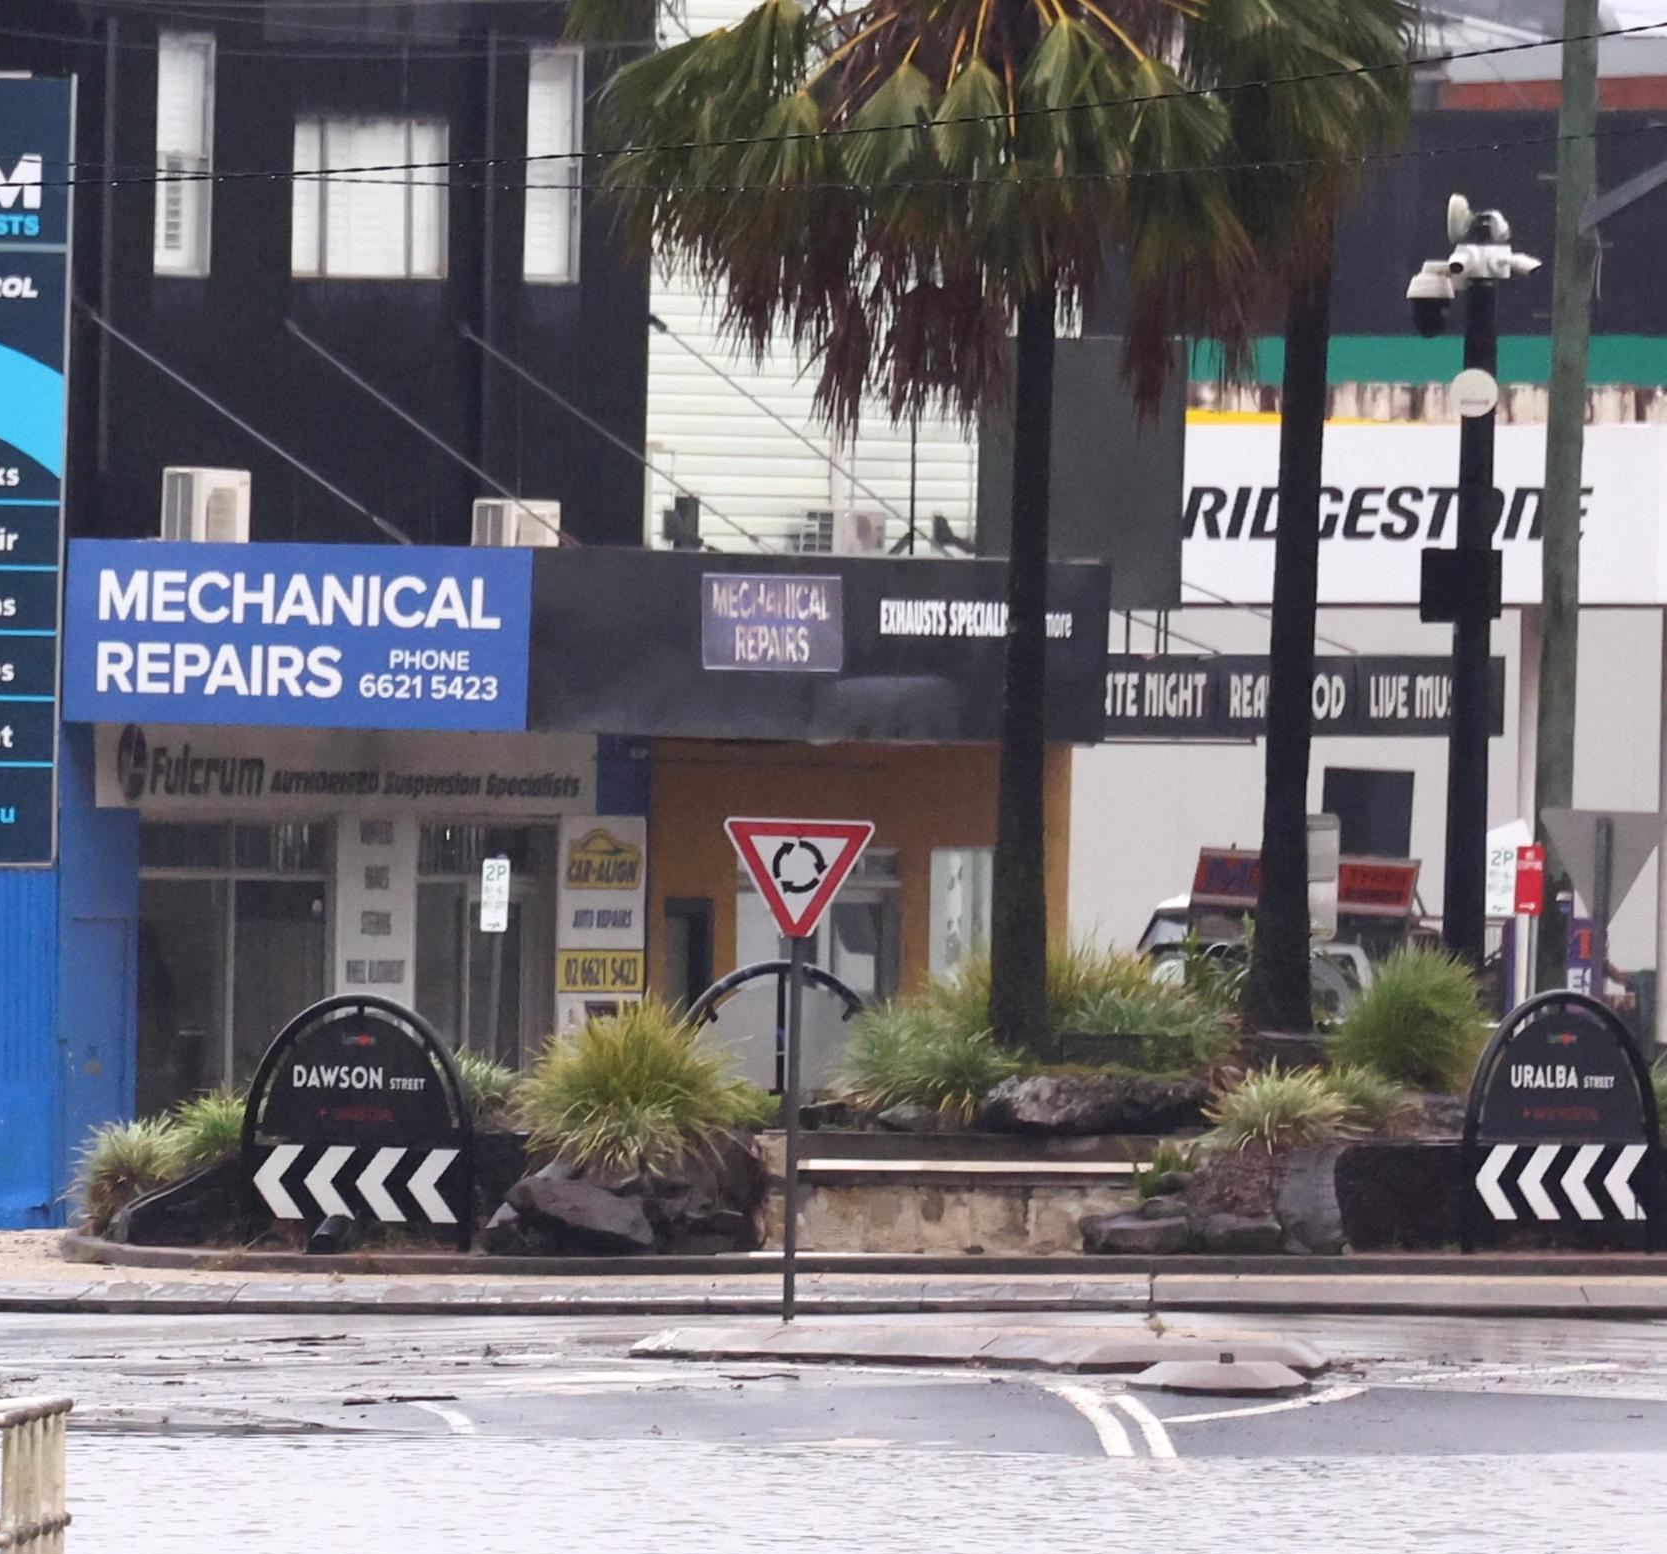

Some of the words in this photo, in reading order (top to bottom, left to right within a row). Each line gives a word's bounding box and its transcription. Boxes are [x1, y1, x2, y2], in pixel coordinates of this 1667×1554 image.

[98, 569, 501, 630] MECHANICAL
[880, 598, 947, 636] EXHAUSTS
[389, 649, 470, 672] PHONE
[735, 624, 810, 663] REPAIRS
[96, 641, 342, 698] REPAIRS
[359, 673, 423, 700] 6621
[430, 675, 499, 701] 5423
[1144, 671, 1207, 718] NIGHT
[1229, 672, 1270, 718] REA
[1369, 675, 1410, 719] LIVE
[150, 743, 266, 796] Fulcrum
[485, 864, 507, 881] 2P
[1490, 850, 1514, 866] 2P
[292, 1064, 384, 1089] DAWSON
[389, 1077, 427, 1090] STREET
[1510, 1064, 1579, 1088] URALBA
[1583, 1075, 1616, 1088] STREET
